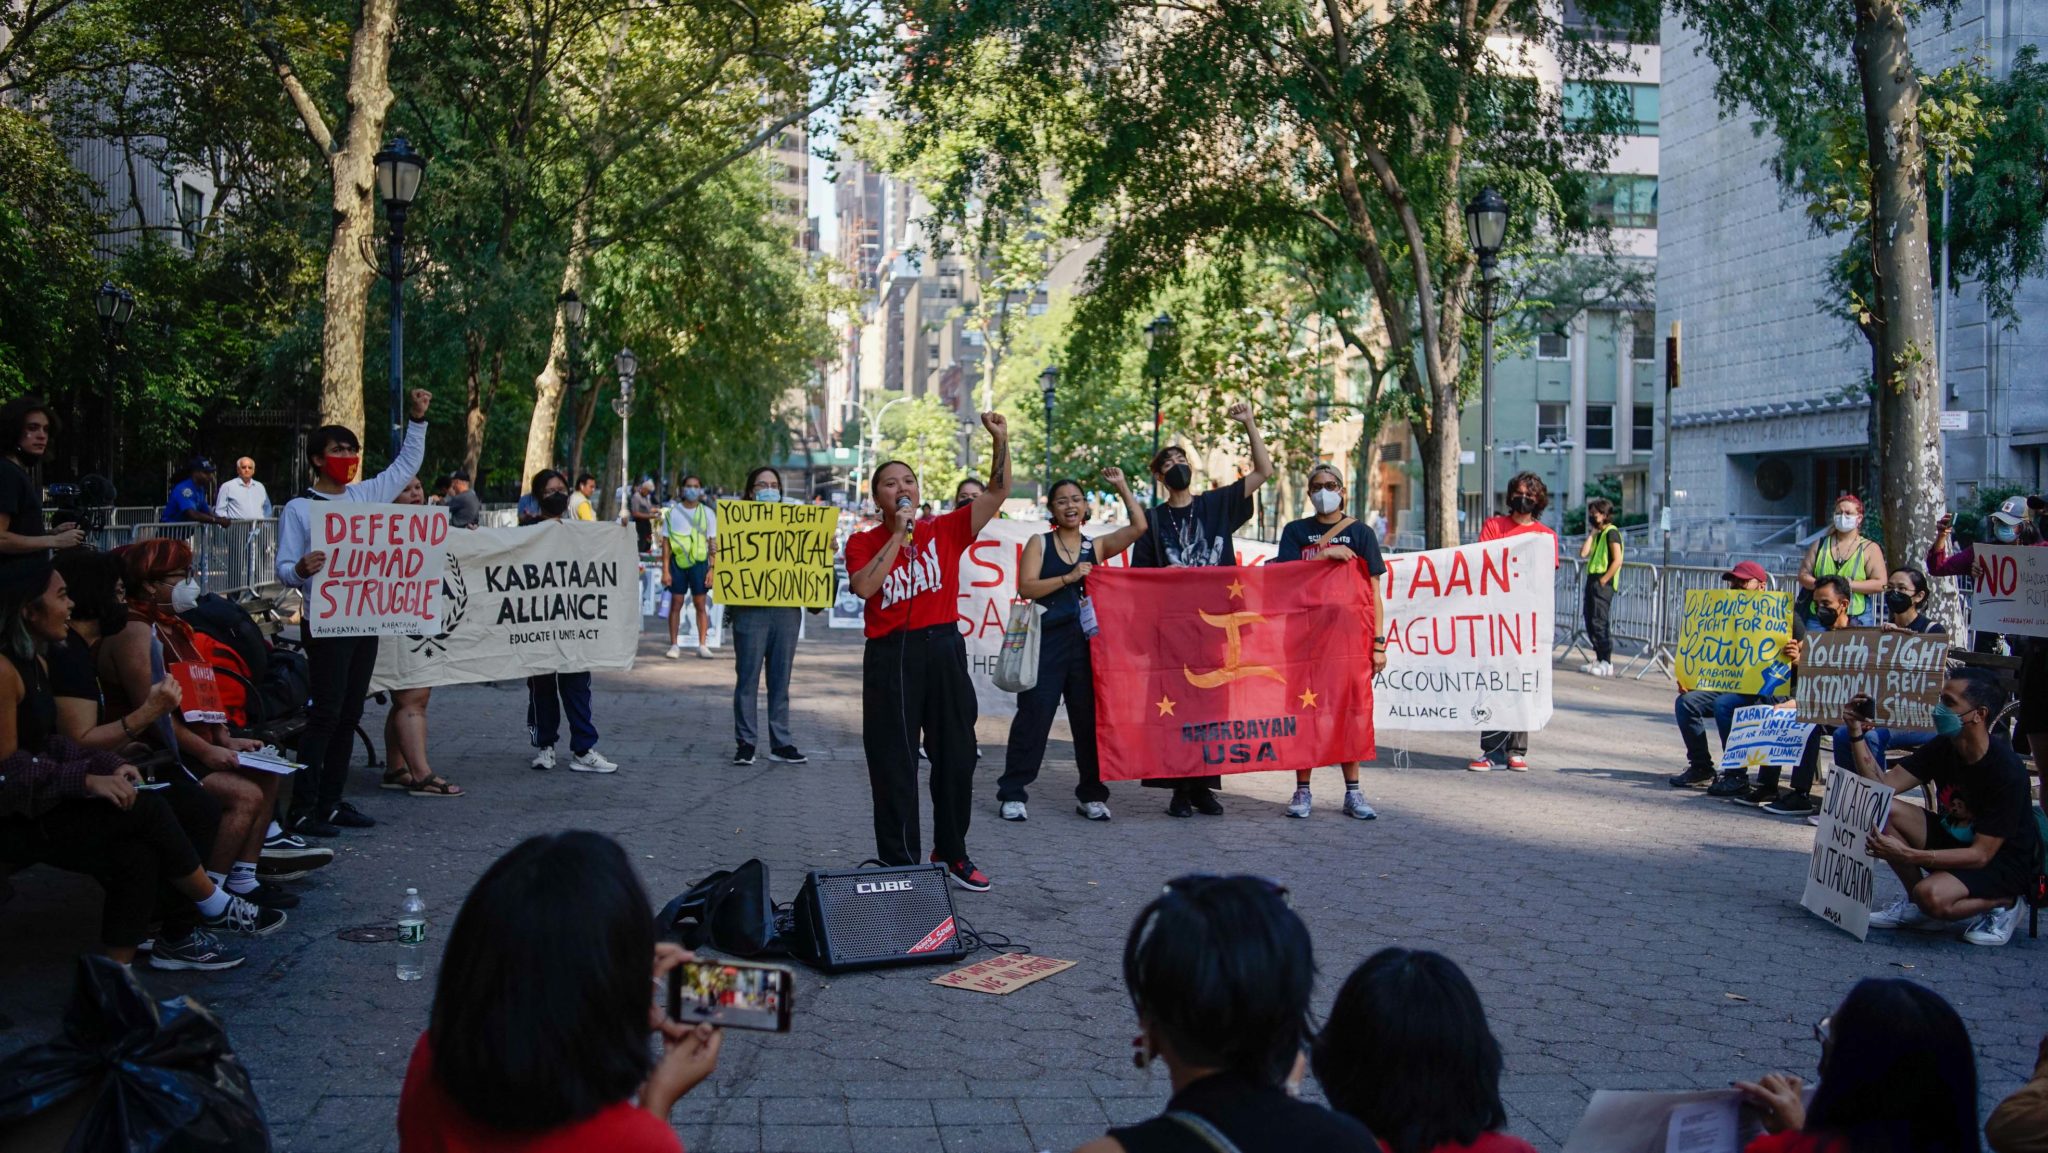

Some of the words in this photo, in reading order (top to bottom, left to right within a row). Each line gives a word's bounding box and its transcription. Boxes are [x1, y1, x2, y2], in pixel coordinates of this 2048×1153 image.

[1818, 414, 1866, 436] CHURC
[718, 501, 773, 525] YOUTH
[780, 505, 830, 525] FIGHT
[325, 512, 447, 546] DEFEND
[716, 530, 834, 568] HISTORICAL
[328, 548, 424, 578] LUMAD
[1976, 554, 2017, 597] NO
[485, 560, 618, 593] KABATAAN
[717, 568, 832, 603] REVISIONISM
[319, 578, 440, 619] STRUGGLE
[496, 594, 608, 625] ALLIANCE
[509, 631, 550, 644] EDUCATE
[578, 629, 599, 640] ACT
[1698, 618, 1729, 632] FIGHT
[1735, 617, 1761, 632] FOR
[1765, 620, 1788, 634] OUR
[1877, 634, 1948, 671] FIGHT
[1374, 670, 1539, 693] ACCOUNTABLE!
[1696, 679, 1742, 690] ALLIANCE
[1389, 705, 1458, 719] ALLIANCE
[1183, 716, 1297, 742] ANAKBAYAN
[1202, 742, 1278, 764] USA
[1769, 747, 1803, 758] ALLIANCE
[1823, 769, 1891, 833] EDUCATION
[1832, 824, 1856, 849] NOT
[856, 880, 913, 893] CUBE
[973, 976, 1008, 991] WE
